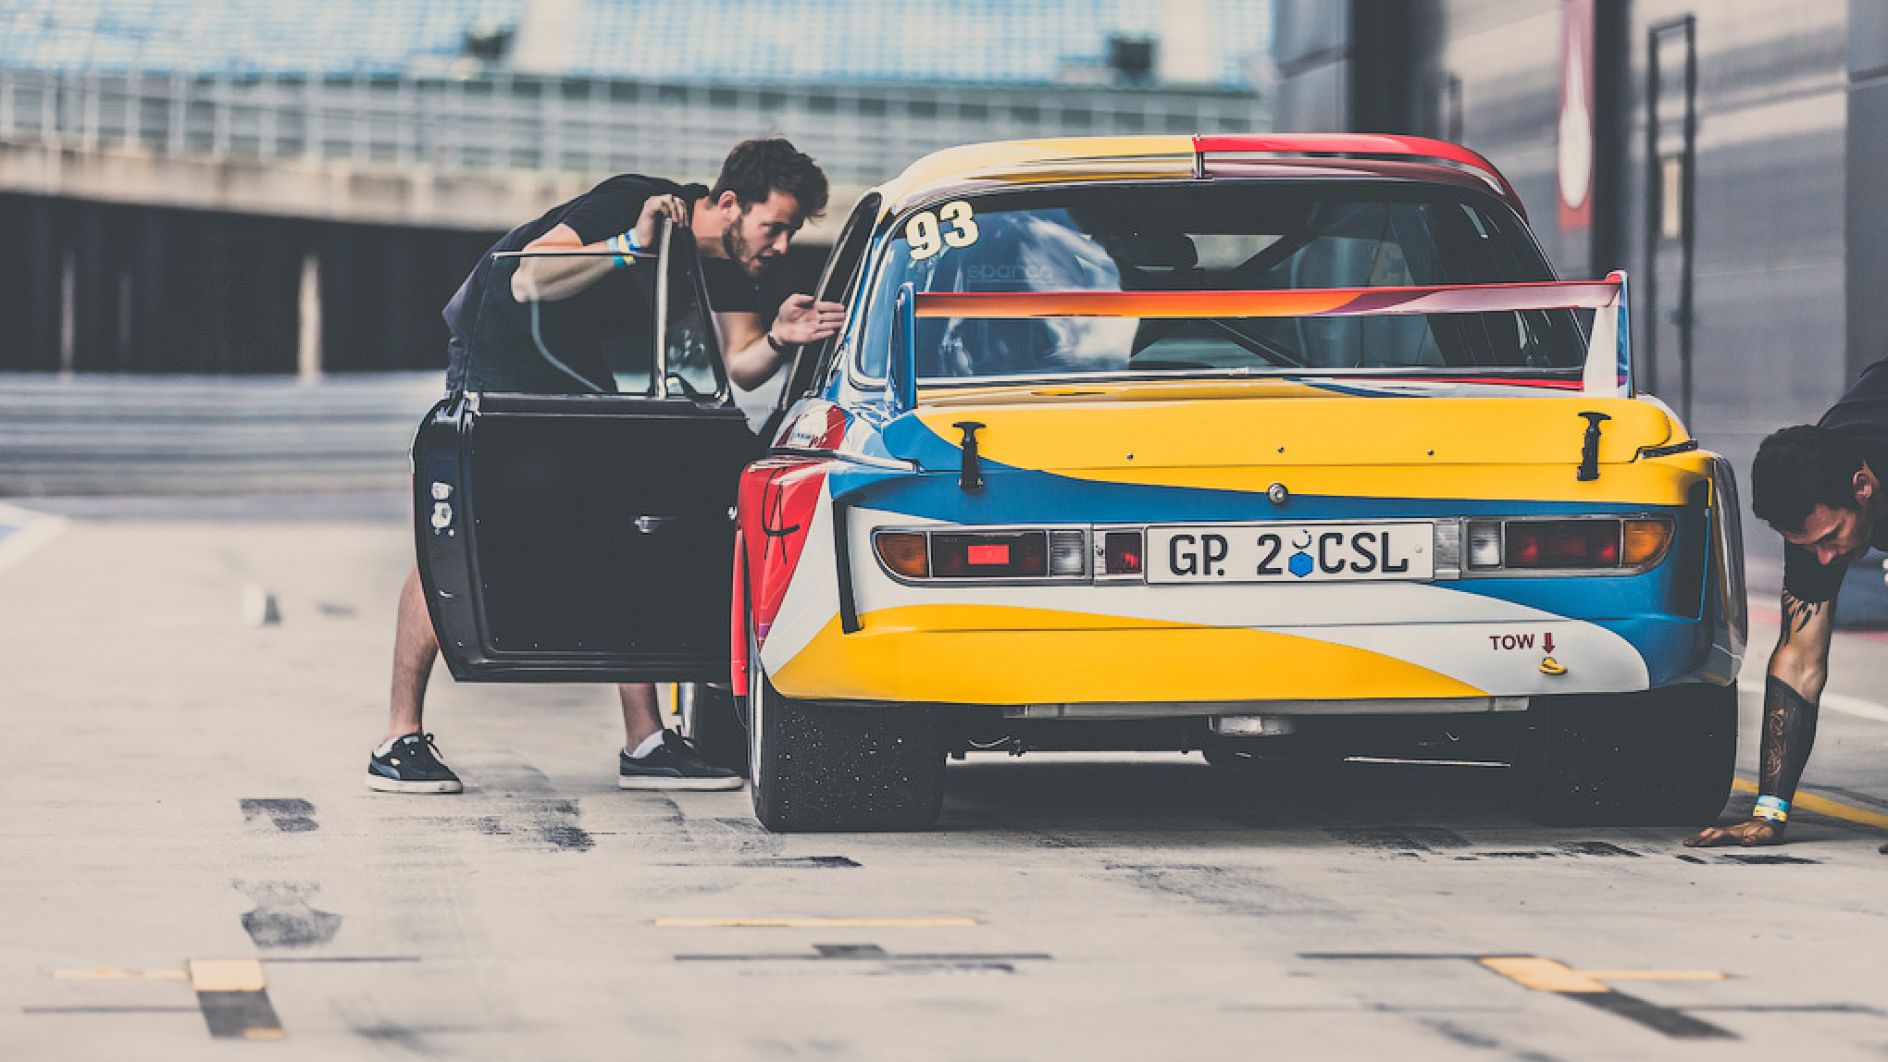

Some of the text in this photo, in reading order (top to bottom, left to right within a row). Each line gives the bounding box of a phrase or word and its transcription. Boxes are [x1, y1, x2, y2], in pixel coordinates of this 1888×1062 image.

[905, 200, 979, 260] 93
[967, 264, 1053, 280] sparco
[1489, 633, 1535, 650] TOW
